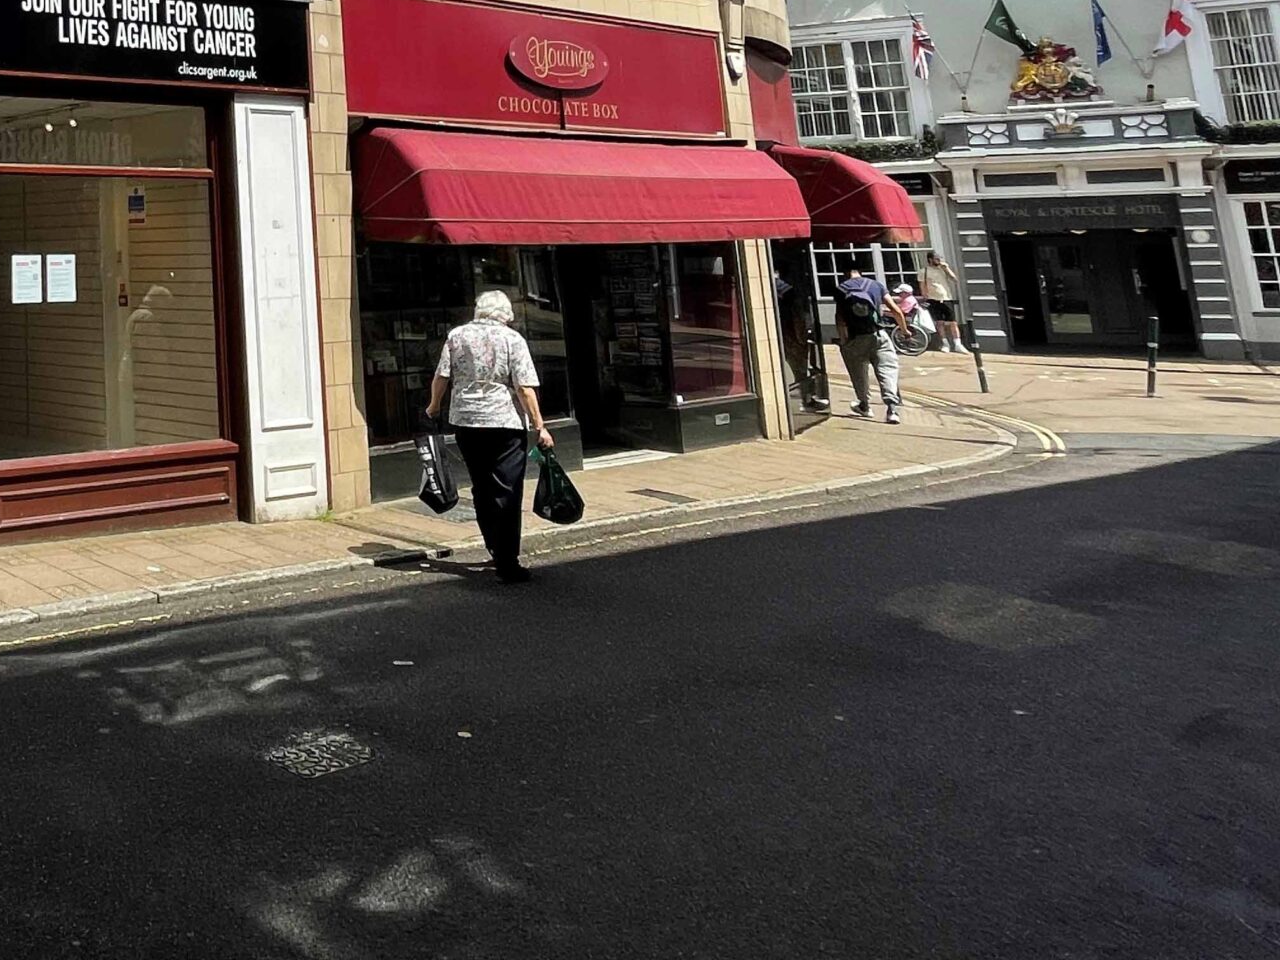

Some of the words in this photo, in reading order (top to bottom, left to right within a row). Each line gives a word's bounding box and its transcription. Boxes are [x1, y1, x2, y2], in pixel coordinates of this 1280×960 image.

[166, 0, 198, 27] FOR
[202, 3, 255, 32] YOUNG
[58, 16, 110, 46] LIVES
[116, 22, 188, 52] AGAINST
[193, 28, 257, 58] CANCER
[178, 61, 258, 81] clicsargent.org.uk
[526, 36, 595, 78] Youings
[498, 96, 590, 117] CHOCOLATE
[593, 103, 620, 120] BOX
[1124, 204, 1165, 215] HOTEL
